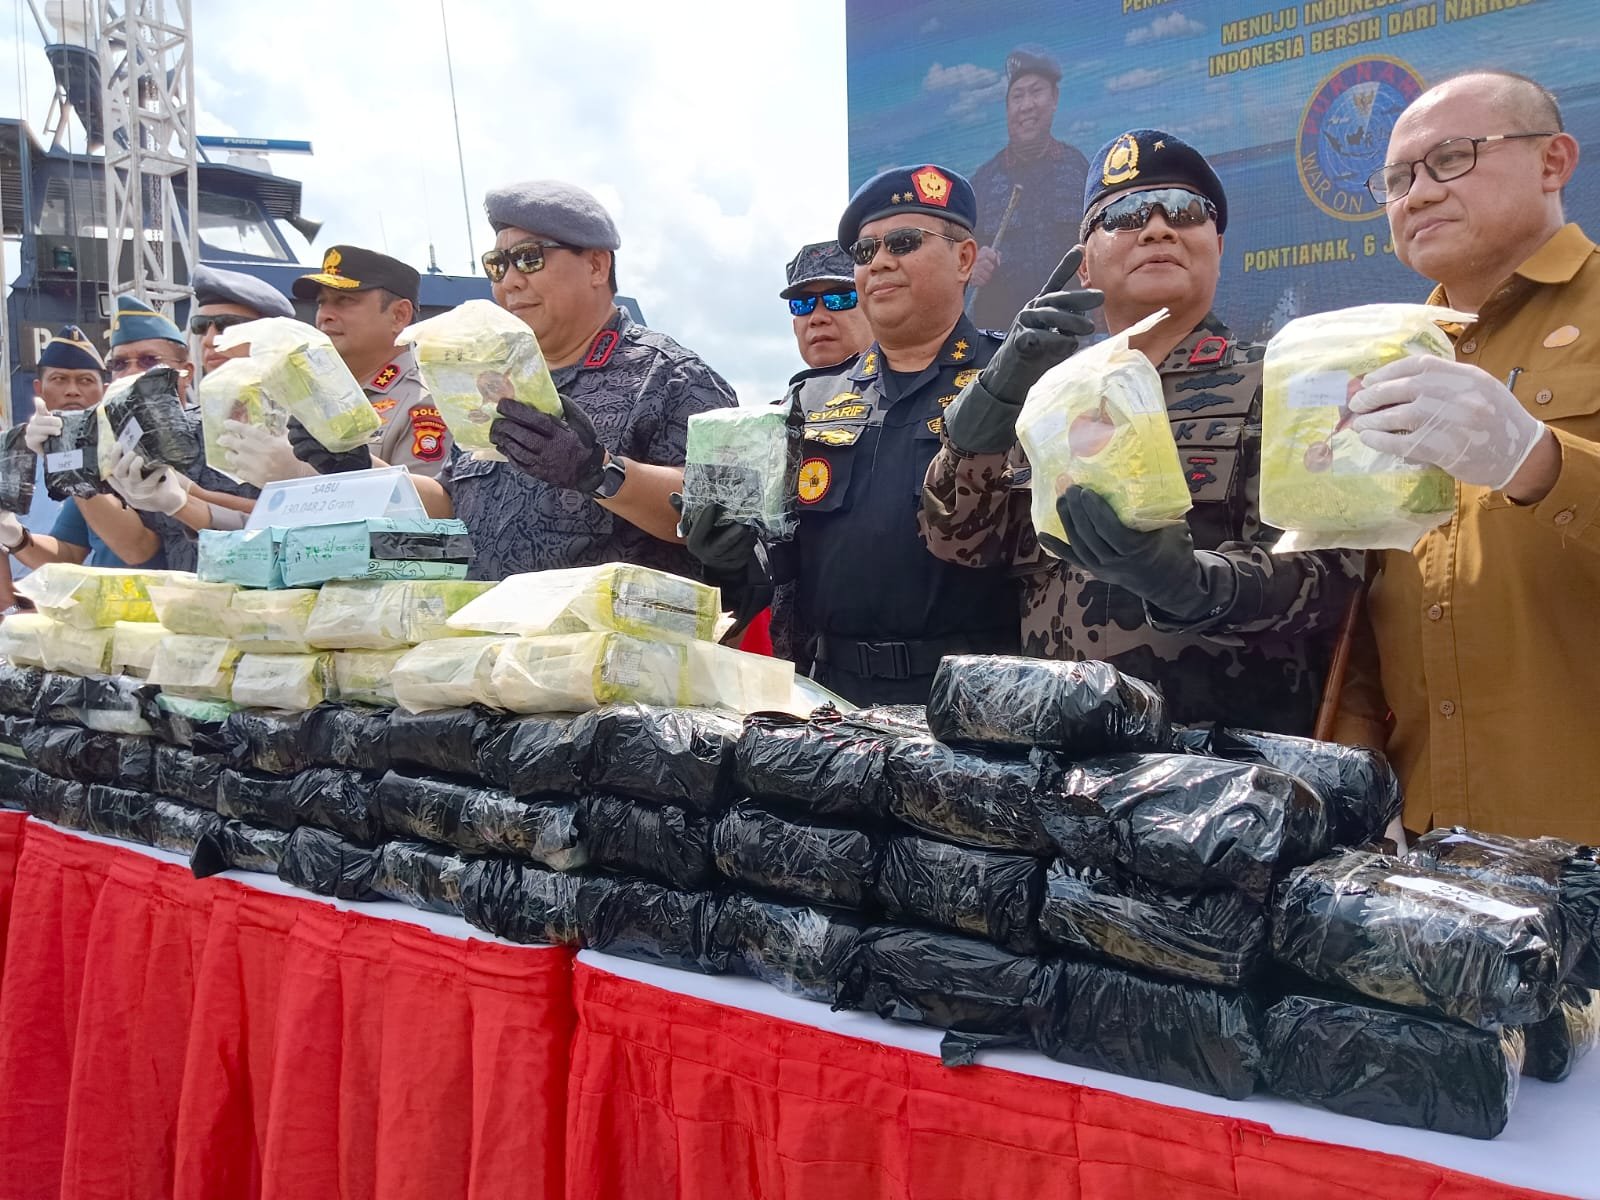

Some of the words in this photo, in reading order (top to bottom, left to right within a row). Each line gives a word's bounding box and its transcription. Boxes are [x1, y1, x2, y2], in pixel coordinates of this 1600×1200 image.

[1209, 36, 1303, 77] INDONESIA
[1311, 17, 1381, 53] BERSIH
[1388, 3, 1437, 36] DARI
[1222, 8, 1297, 44] MENUJU
[1302, 151, 1332, 198] WAR
[1333, 191, 1363, 213] ON
[1244, 239, 1356, 272] PONTIANAK,
[1364, 234, 1375, 256] 6
[809, 405, 865, 421] SYARIF
[311, 482, 340, 495] SABU
